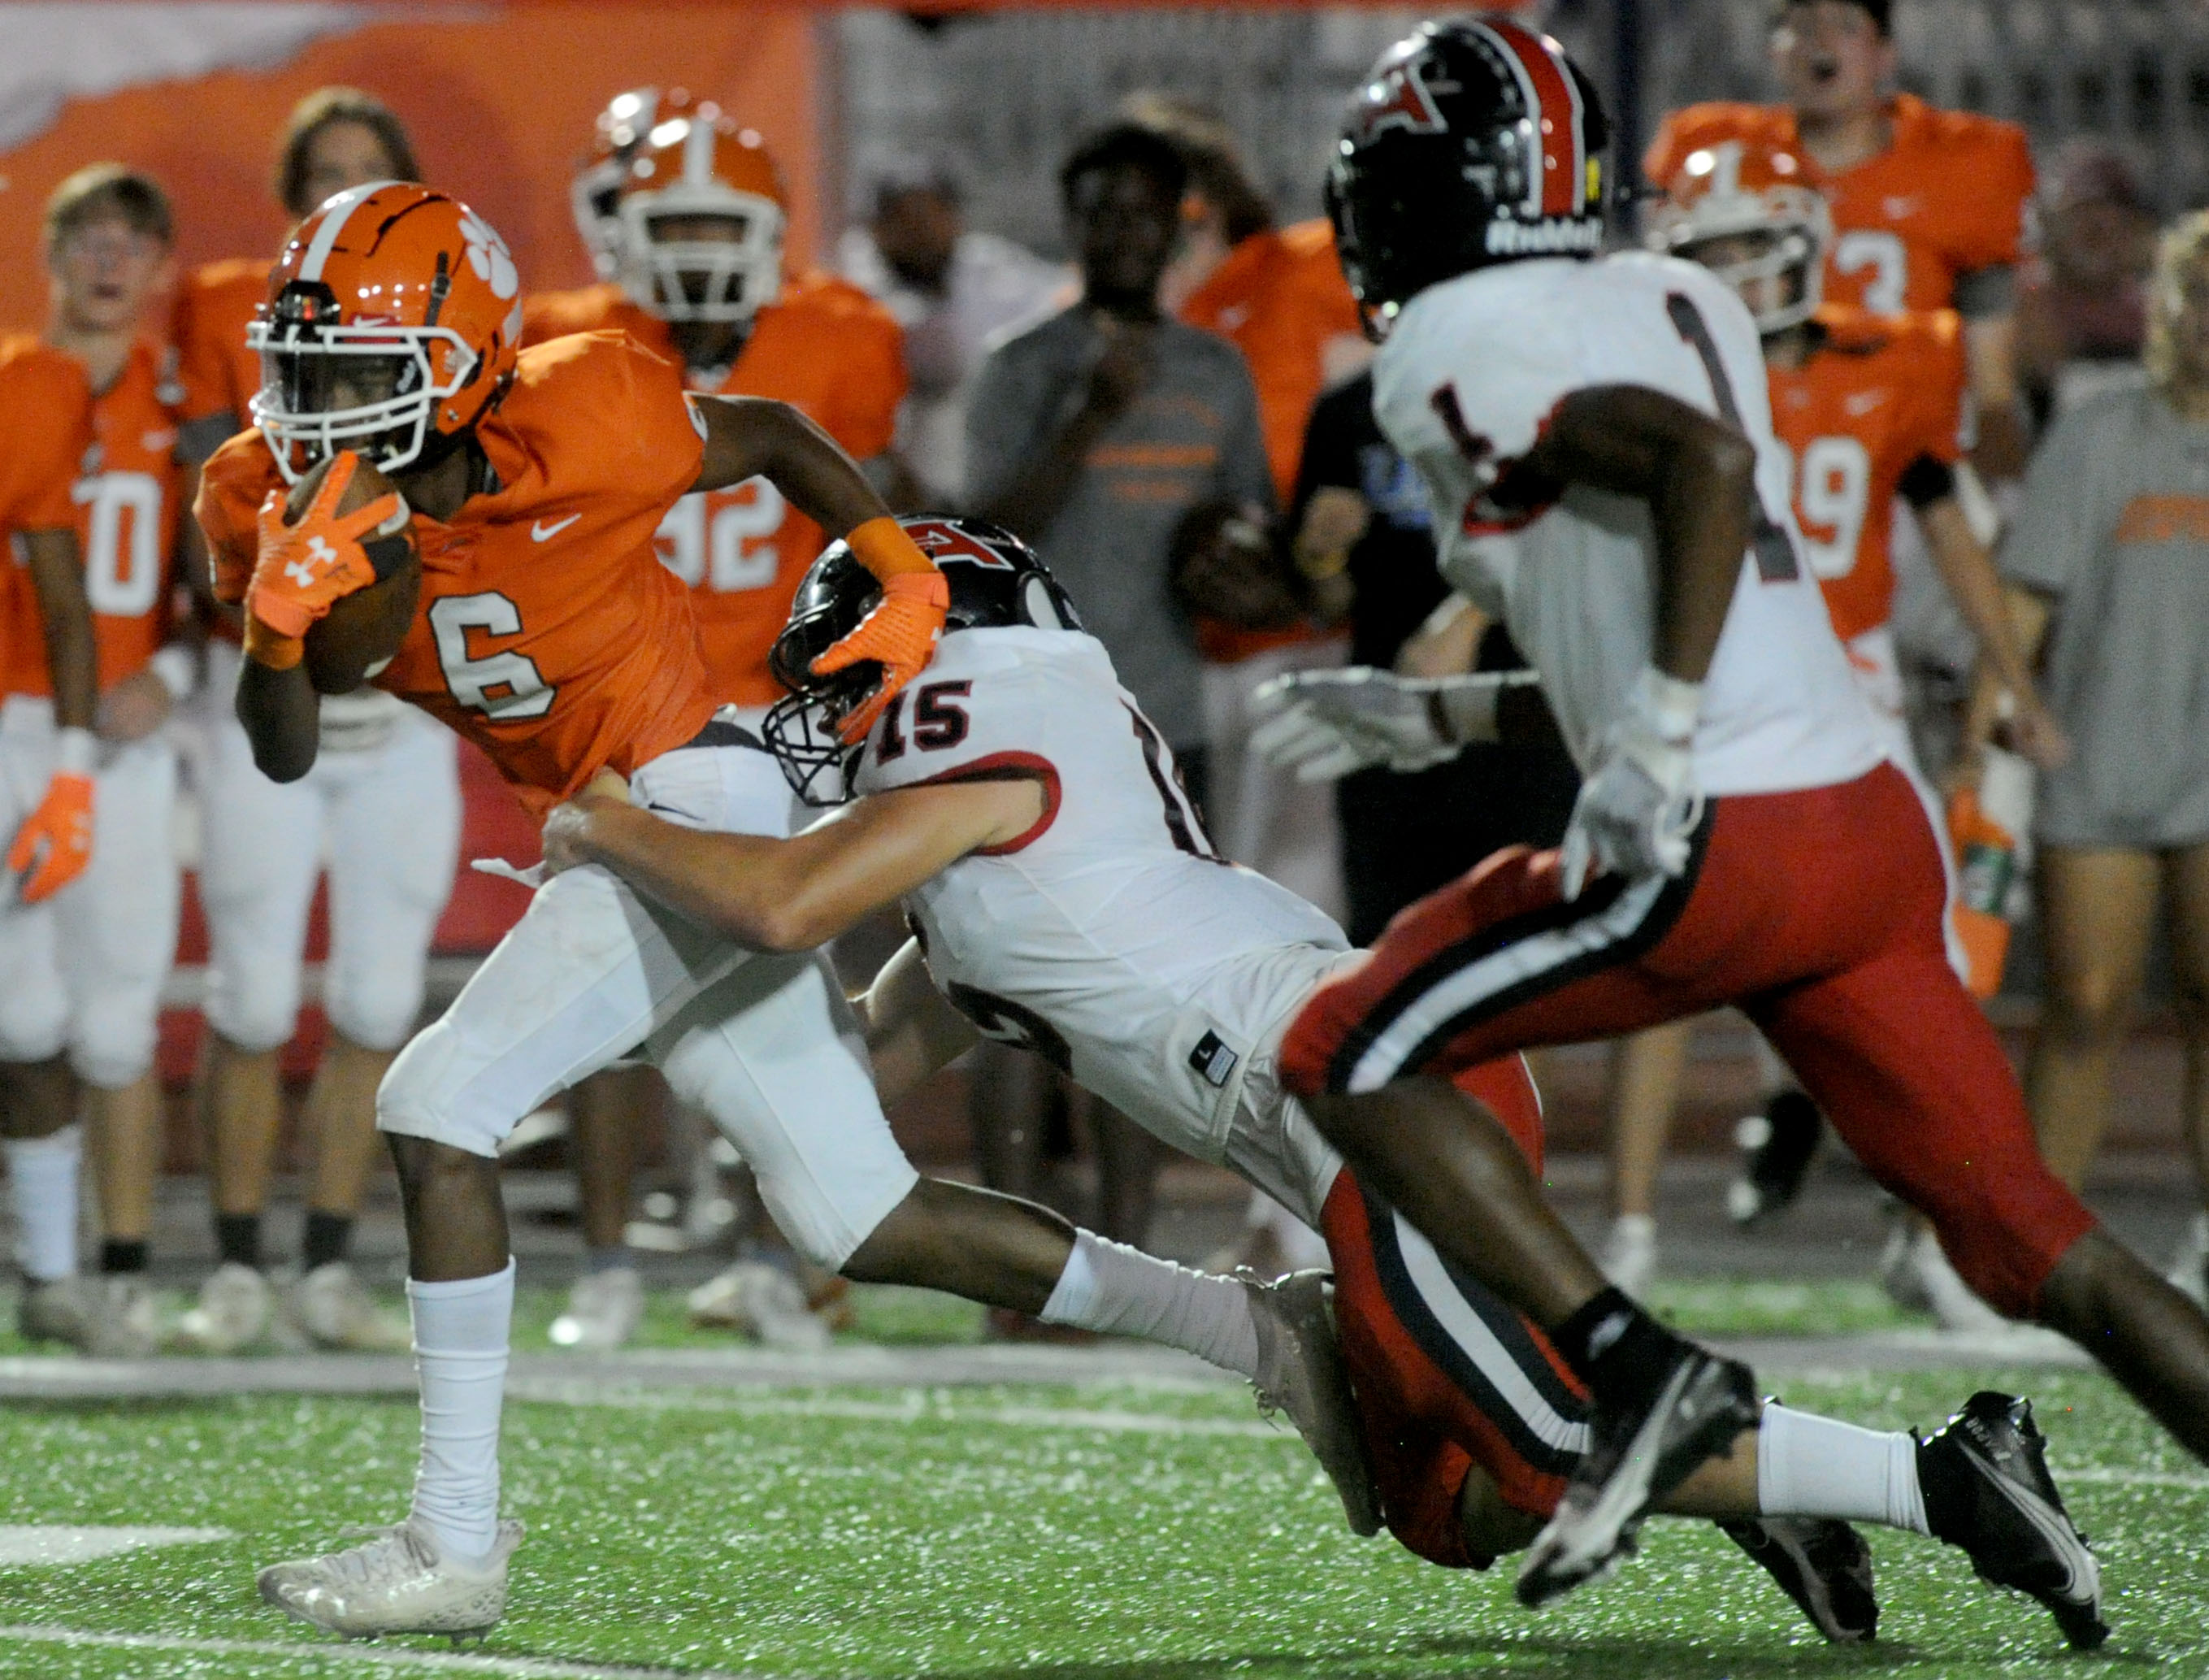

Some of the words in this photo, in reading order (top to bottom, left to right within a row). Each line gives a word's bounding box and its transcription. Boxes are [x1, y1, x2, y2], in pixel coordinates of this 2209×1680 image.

[1773, 435, 1871, 580] 9
[427, 590, 558, 723] 6
[876, 679, 973, 768] 15
